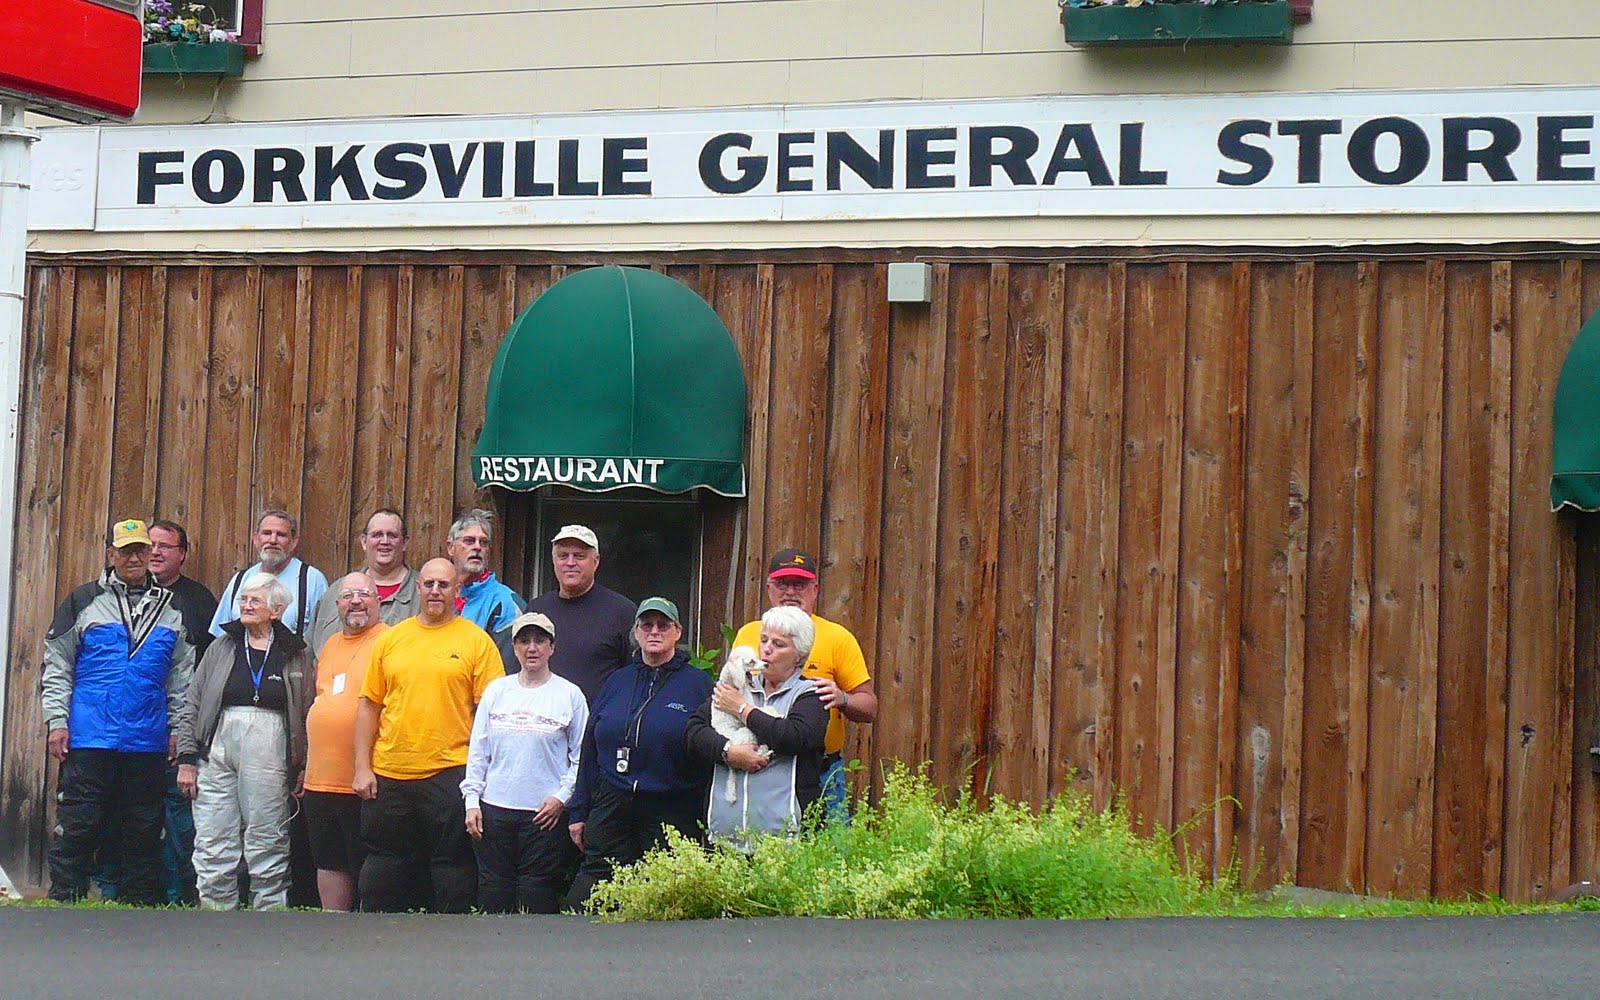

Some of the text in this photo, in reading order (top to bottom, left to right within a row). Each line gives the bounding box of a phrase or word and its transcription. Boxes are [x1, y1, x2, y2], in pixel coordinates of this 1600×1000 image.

[137, 115, 1595, 204] FORKSVILLE GENERAL STORE
[480, 456, 664, 484] RESTAURANT
